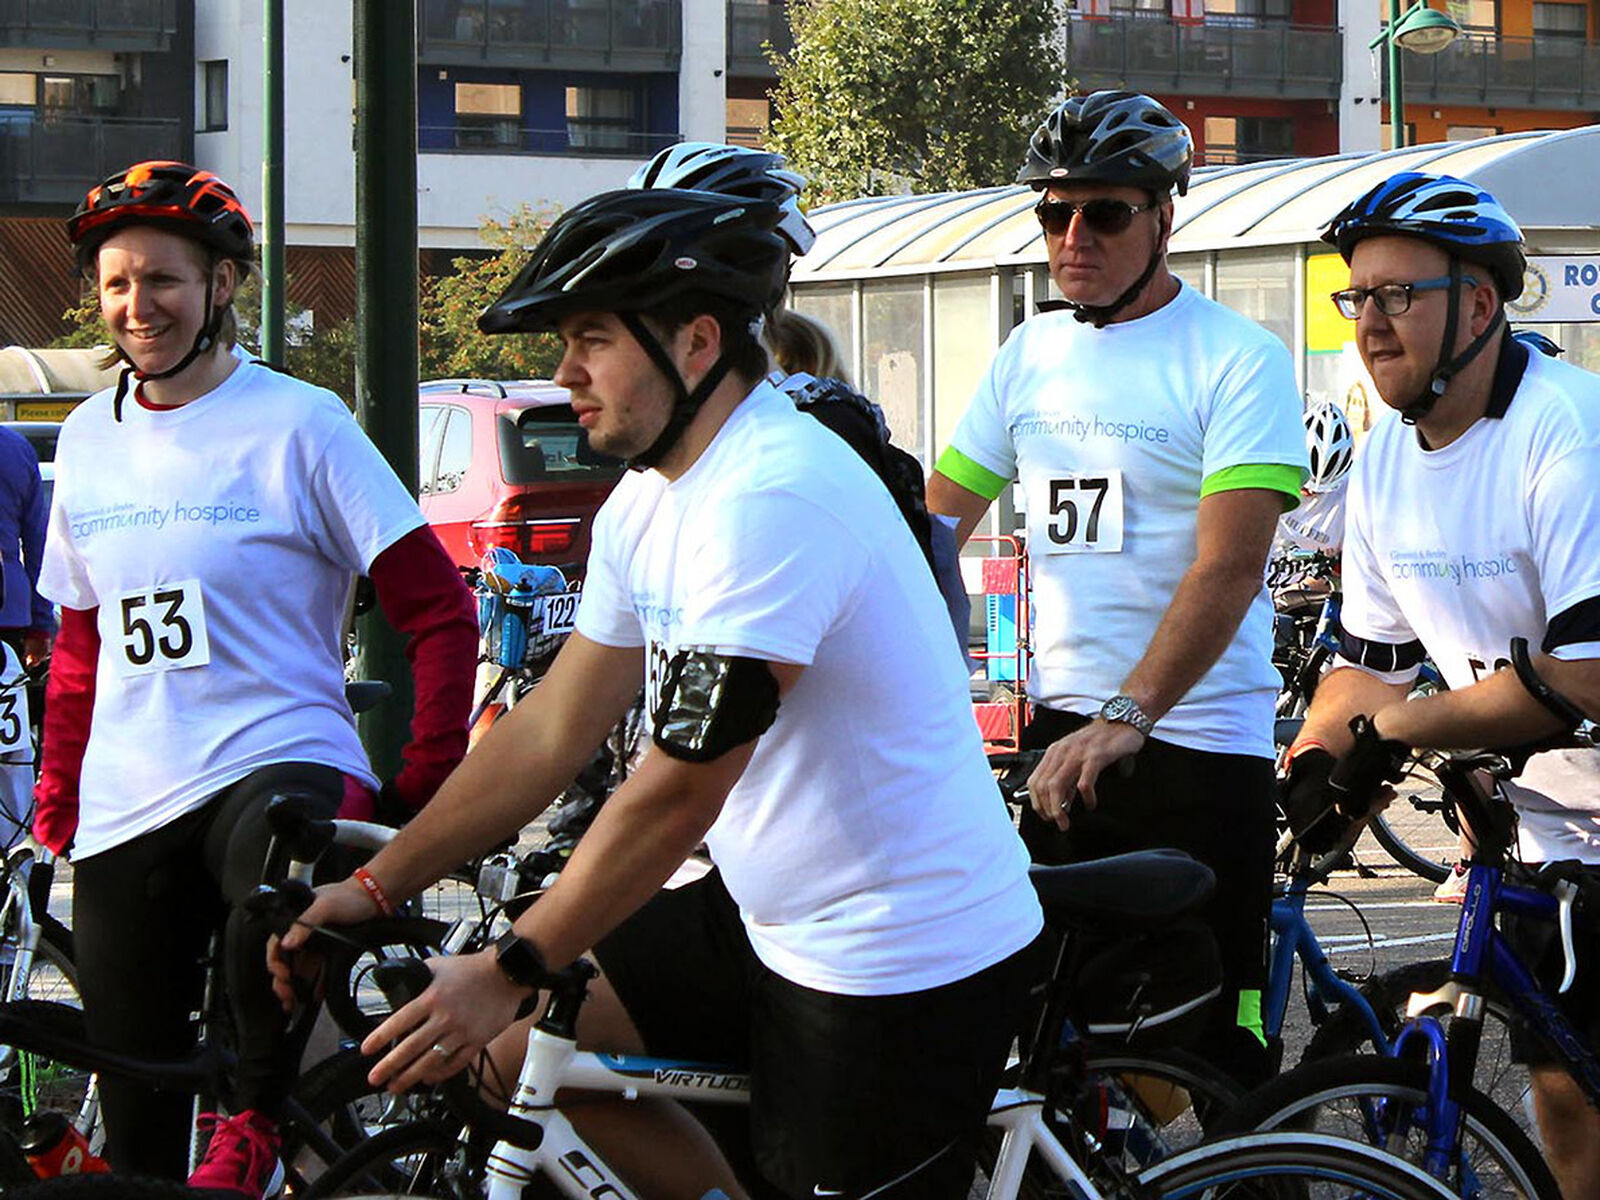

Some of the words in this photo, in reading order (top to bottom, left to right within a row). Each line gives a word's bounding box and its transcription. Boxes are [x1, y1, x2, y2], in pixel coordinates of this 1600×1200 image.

[1564, 265, 1600, 286] RO
[1094, 414, 1169, 443] hospice
[71, 505, 170, 540] community
[173, 500, 260, 526] hospice
[1048, 478, 1109, 544] 57
[121, 589, 193, 666] 53
[547, 596, 576, 630] 122
